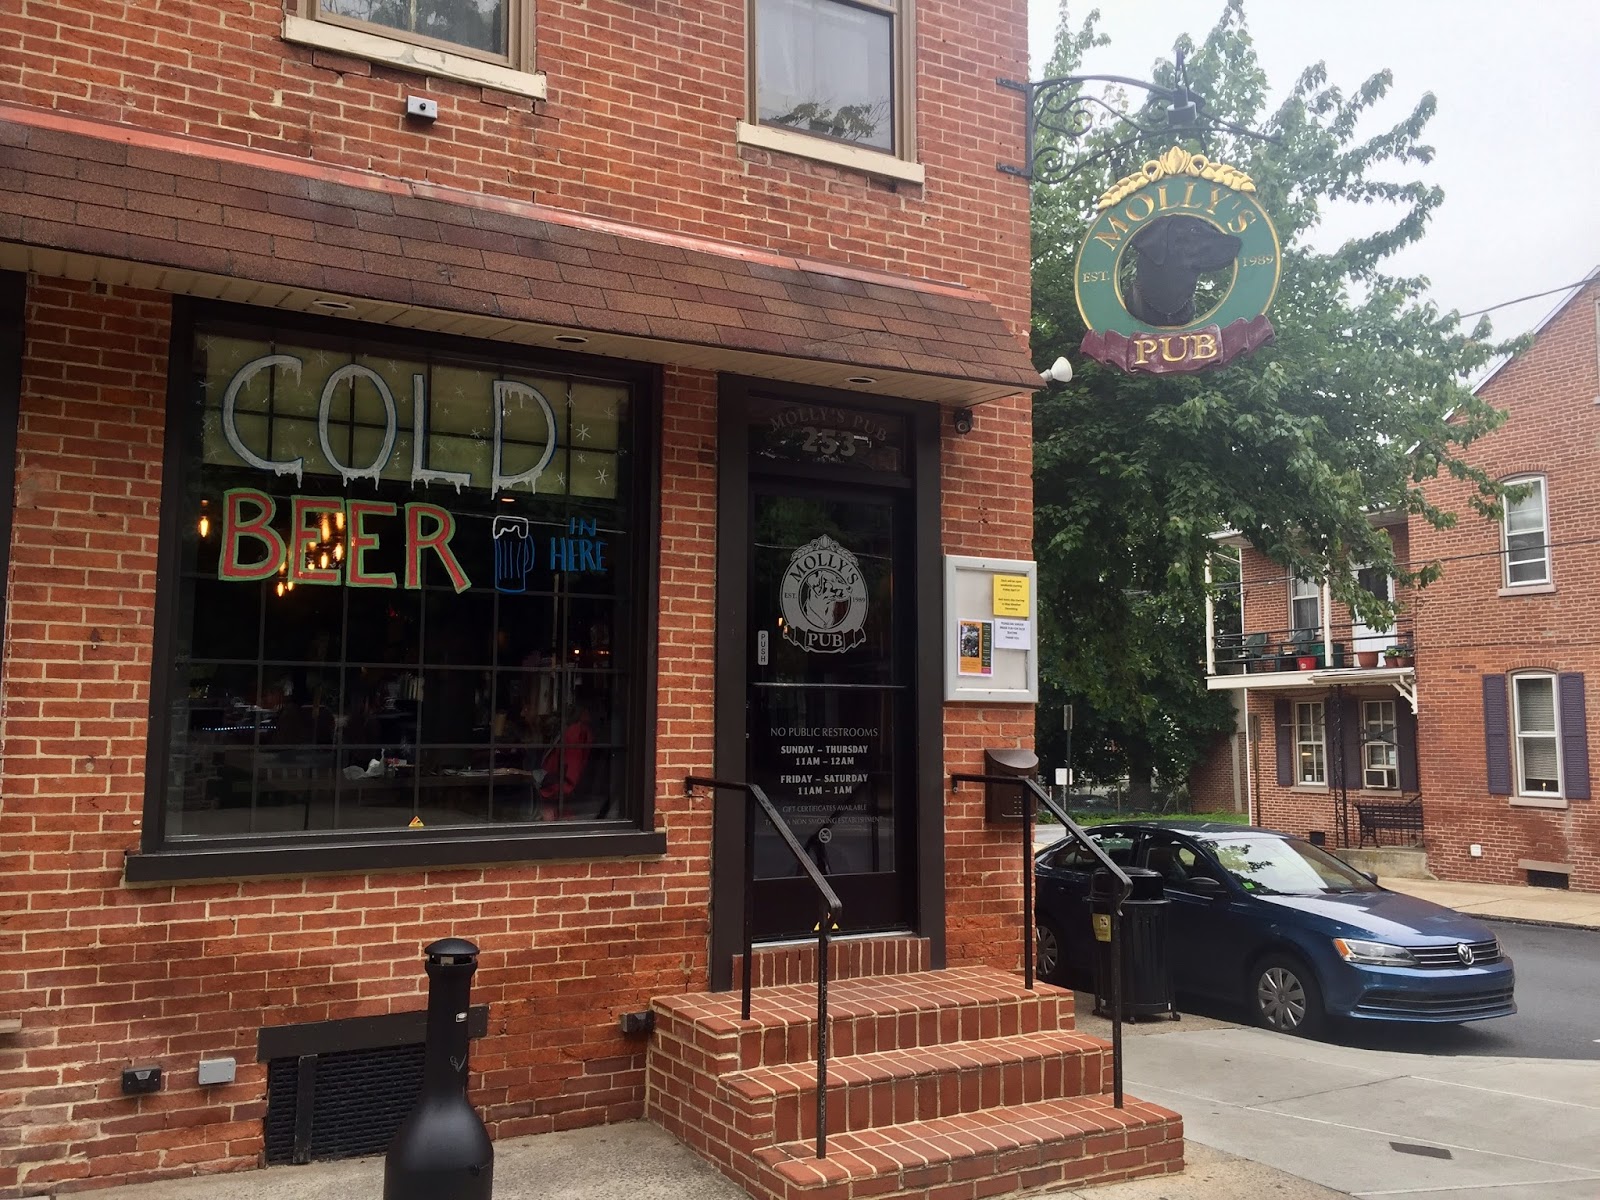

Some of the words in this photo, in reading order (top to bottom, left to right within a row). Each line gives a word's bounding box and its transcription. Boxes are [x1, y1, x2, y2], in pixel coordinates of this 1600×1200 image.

[1093, 182, 1257, 251] MOLLY'S
[1082, 271, 1110, 283] EST.
[1242, 255, 1274, 267] 1989
[1133, 334, 1218, 364] PUB
[222, 354, 557, 500] COLD
[769, 407, 848, 432] MOLLY'S
[852, 414, 888, 442] PUB
[802, 426, 857, 457] 253
[569, 516, 597, 537] IN
[218, 488, 472, 594] BEER
[550, 536, 609, 572] HERE
[789, 553, 859, 585] MOLLY'S
[807, 632, 843, 648] PUB
[770, 727, 787, 737] NO
[788, 727, 821, 737] PUBLIC
[822, 727, 879, 737] RESTROOMS
[780, 745, 814, 754] SUNDAY
[825, 745, 869, 754] THURSDAY
[795, 757, 821, 766] 11AM
[830, 756, 855, 765] 12AM
[780, 775, 813, 784] FRIDAY
[824, 774, 869, 783] SATURDAY
[798, 786, 823, 795] 11AM
[833, 786, 853, 794] 1AM
[796, 804, 836, 813] CERTIFICATES
[837, 803, 867, 812] AVAILABLE
[808, 817, 837, 825] SMOKING
